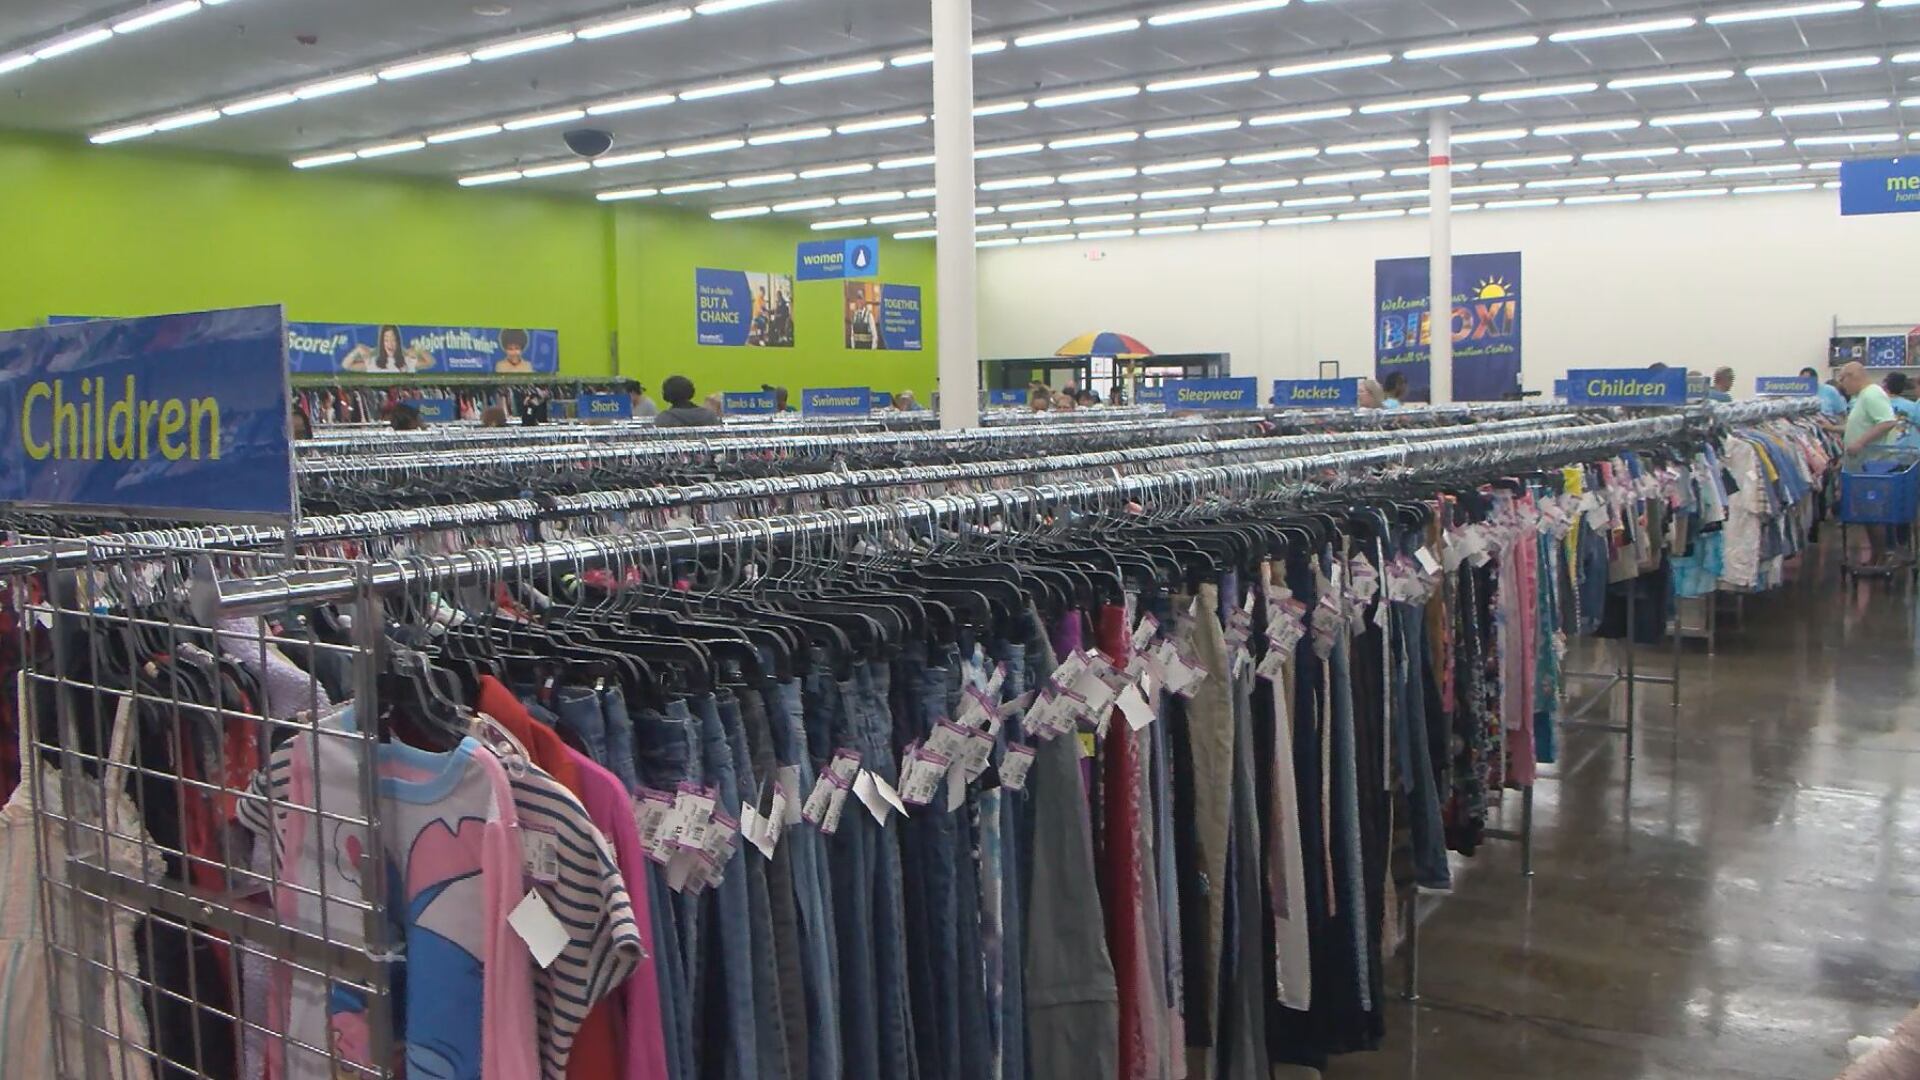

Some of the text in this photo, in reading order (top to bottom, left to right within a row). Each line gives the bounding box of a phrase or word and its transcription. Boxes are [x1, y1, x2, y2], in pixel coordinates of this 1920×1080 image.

[803, 253, 844, 265] women
[700, 296, 729, 309] BUT A
[1381, 296, 1427, 311] Welcome
[700, 310, 740, 324] CHANCE
[1290, 385, 1341, 400] Jackets
[1587, 379, 1666, 396] Children
[1764, 381, 1809, 392] Sweaters
[812, 393, 861, 407] Swimwear
[1178, 388, 1244, 404] Sleepwear
[591, 400, 620, 412] Shorts
[23, 374, 221, 461] Children
